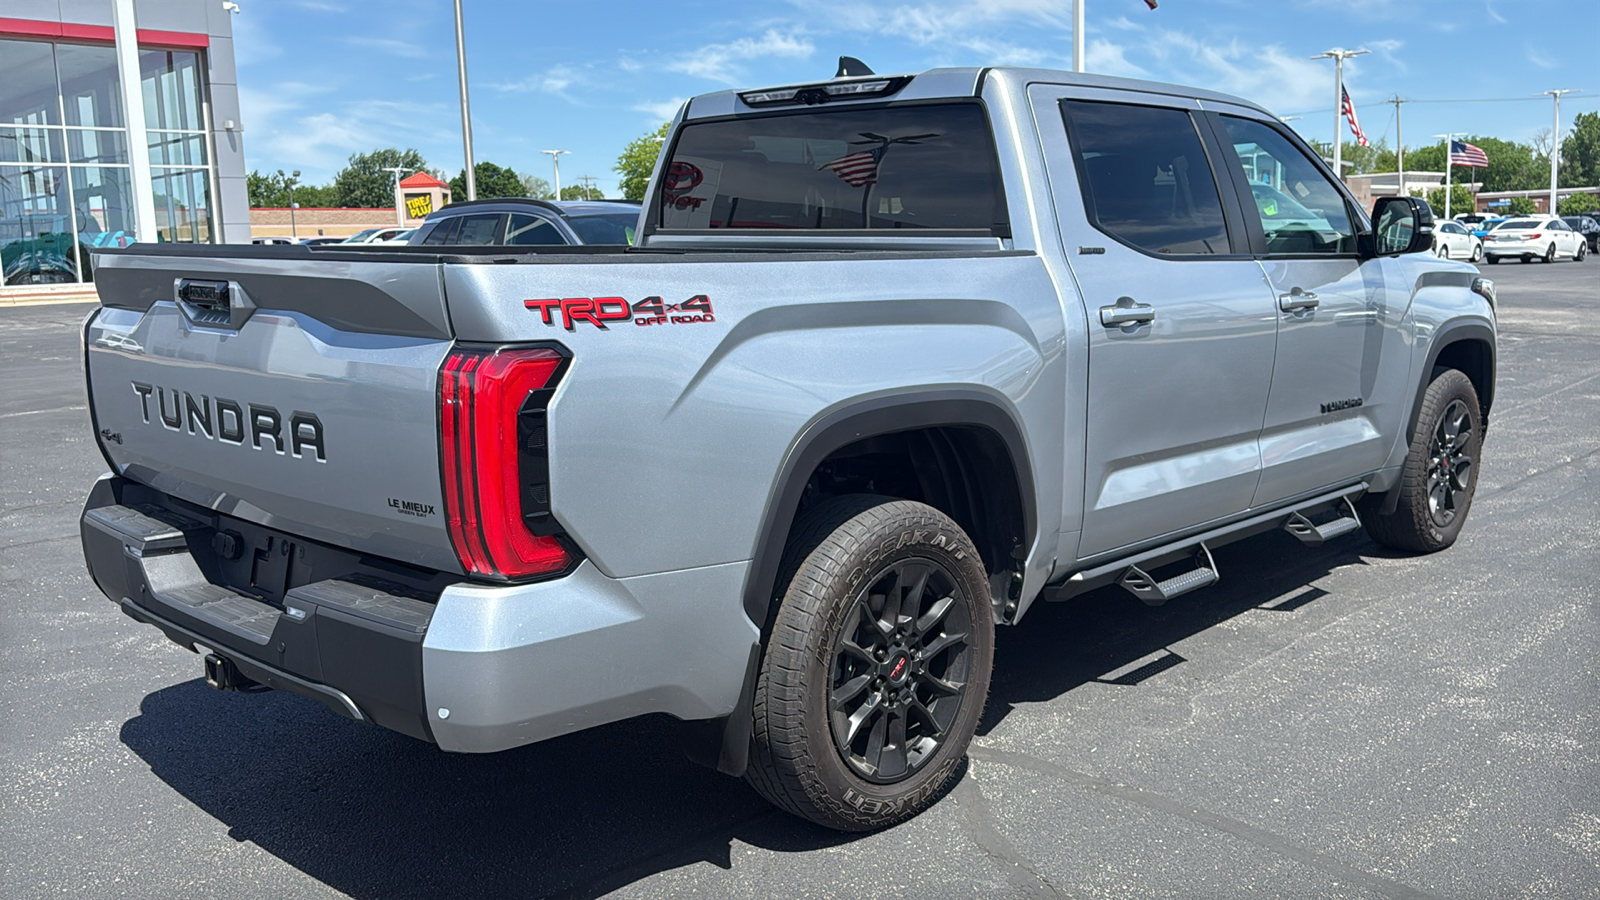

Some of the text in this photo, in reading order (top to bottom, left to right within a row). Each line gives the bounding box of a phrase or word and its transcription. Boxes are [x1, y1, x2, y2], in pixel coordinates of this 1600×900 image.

[406, 194, 430, 209] TIRES
[410, 204, 432, 219] PLUS
[524, 297, 634, 333] TRD
[634, 314, 716, 326] OFF ROAD
[1320, 398, 1363, 414] TUNDRA
[131, 380, 327, 463] TUNDRA
[387, 497, 436, 515] LE MIEUX
[397, 508, 415, 516] GREEN
[890, 657, 906, 677] TRD
